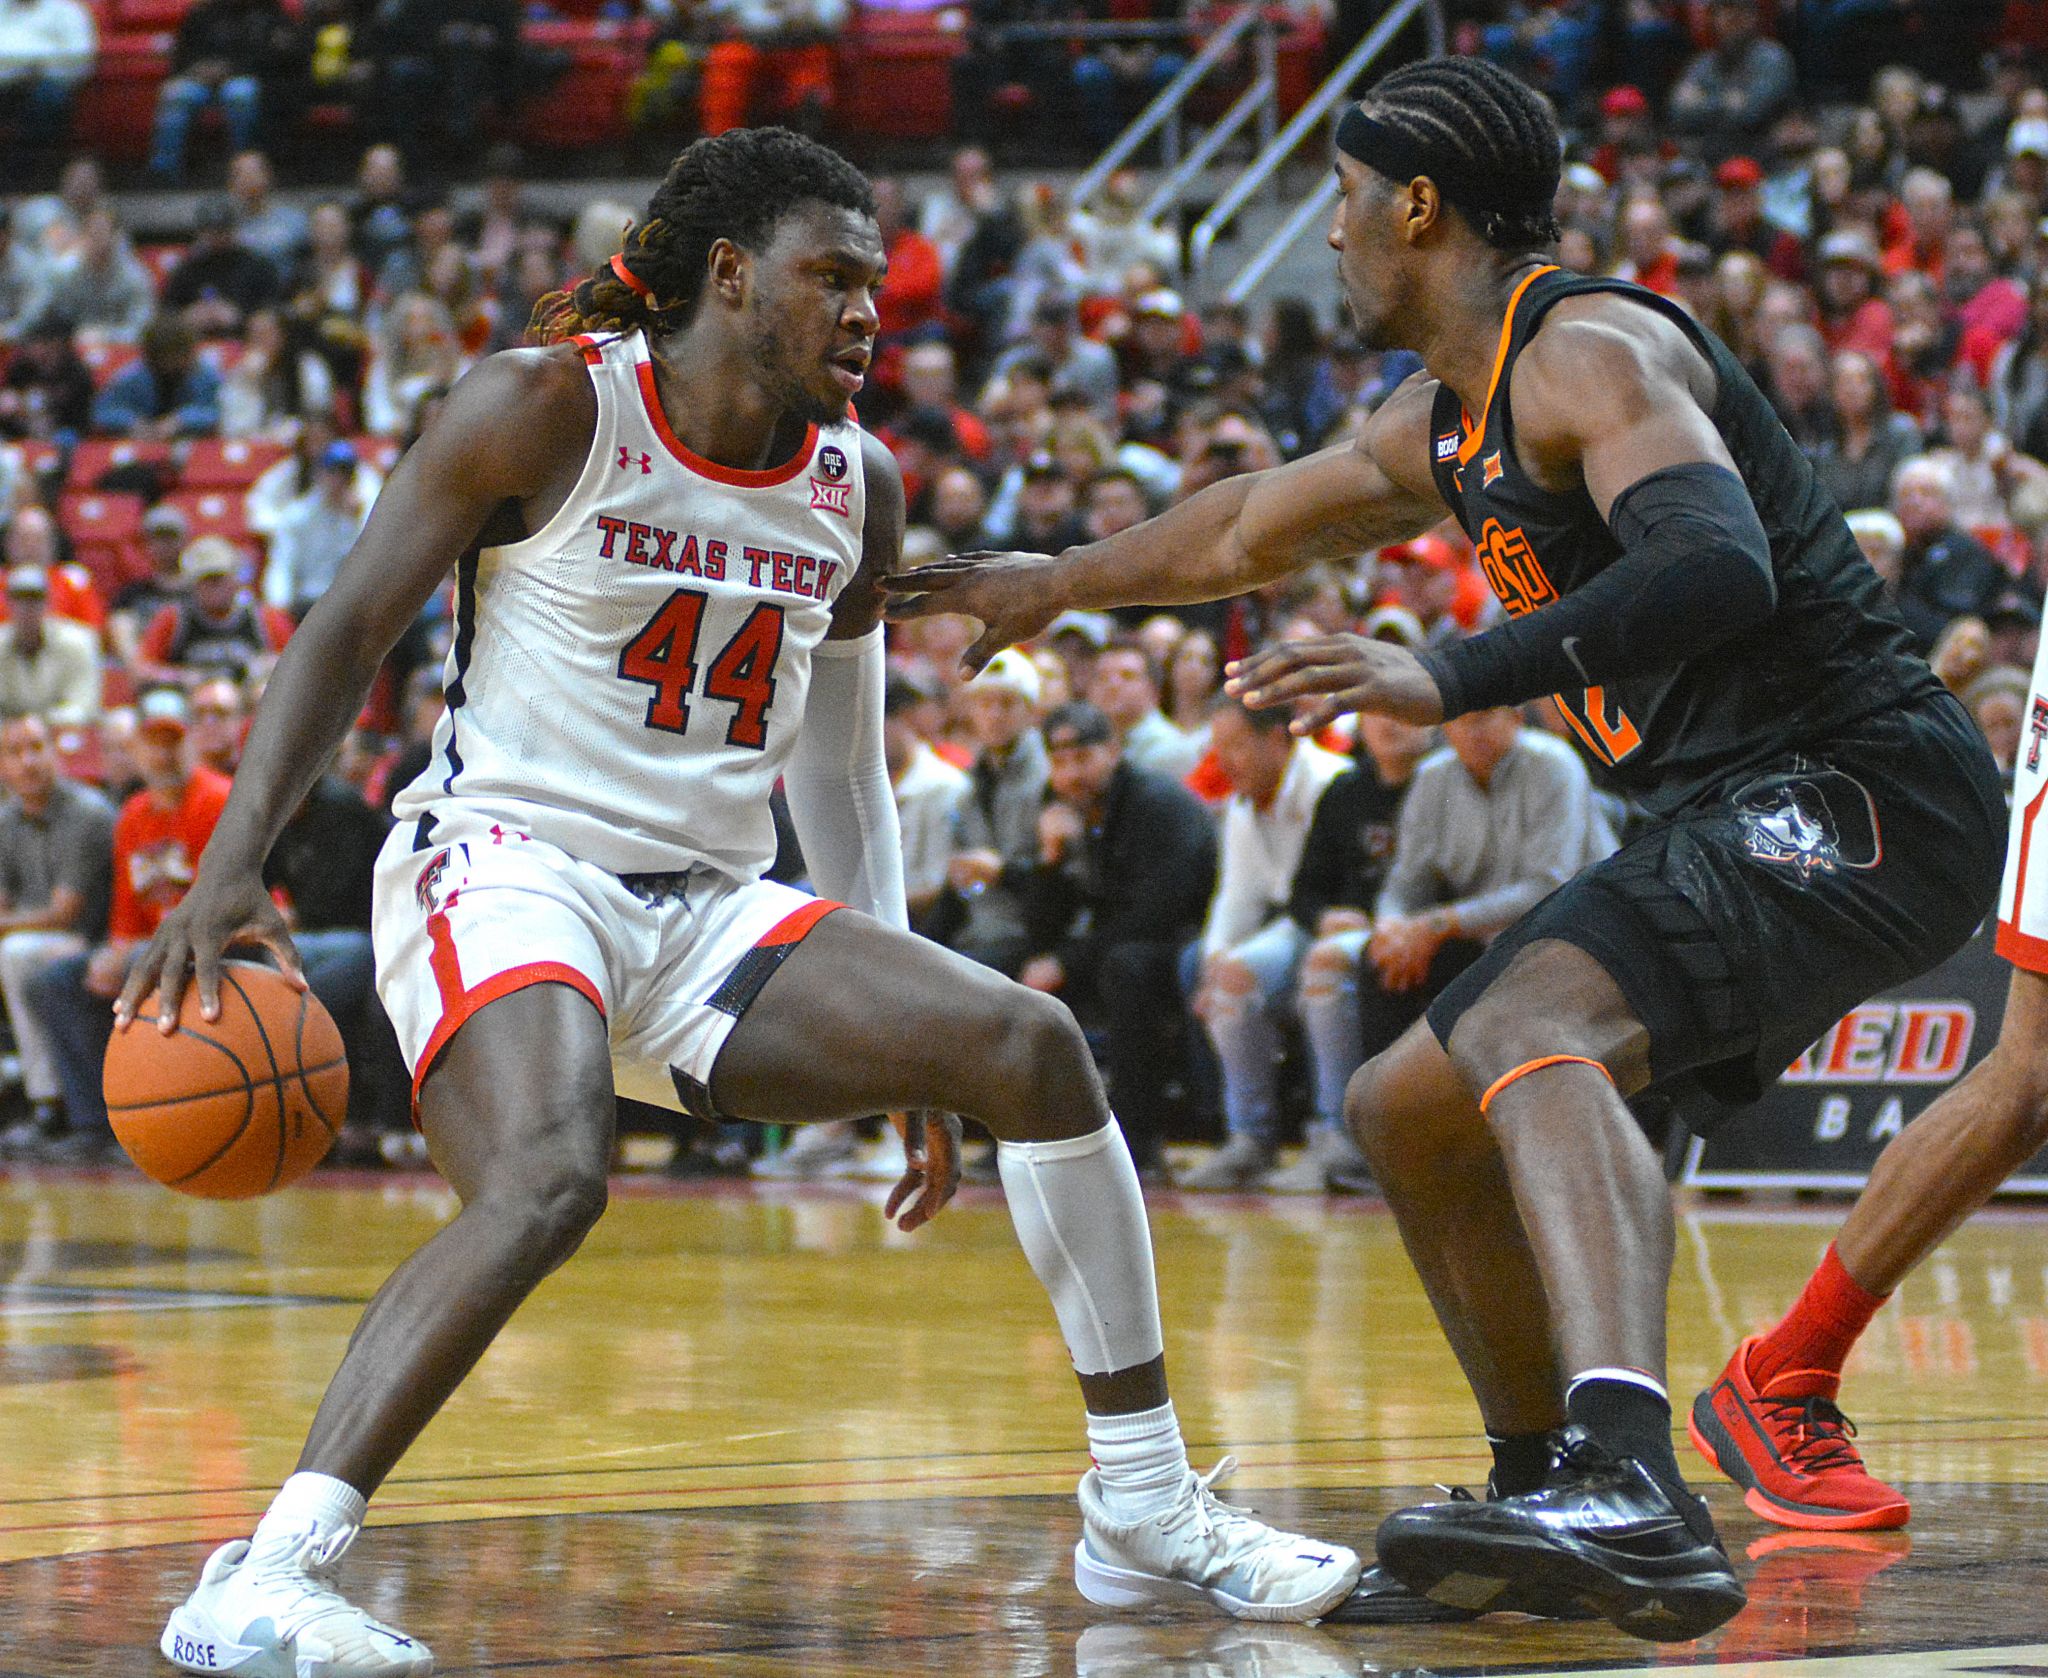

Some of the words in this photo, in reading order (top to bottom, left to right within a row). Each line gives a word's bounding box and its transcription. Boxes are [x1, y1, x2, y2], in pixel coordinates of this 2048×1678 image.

[824, 453, 842, 467] DRE
[597, 515, 728, 581] TEXAS
[743, 546, 838, 601] TECH
[617, 588, 785, 751] 44
[1778, 1003, 1976, 1083] ED
[173, 1634, 217, 1667] ROSE
